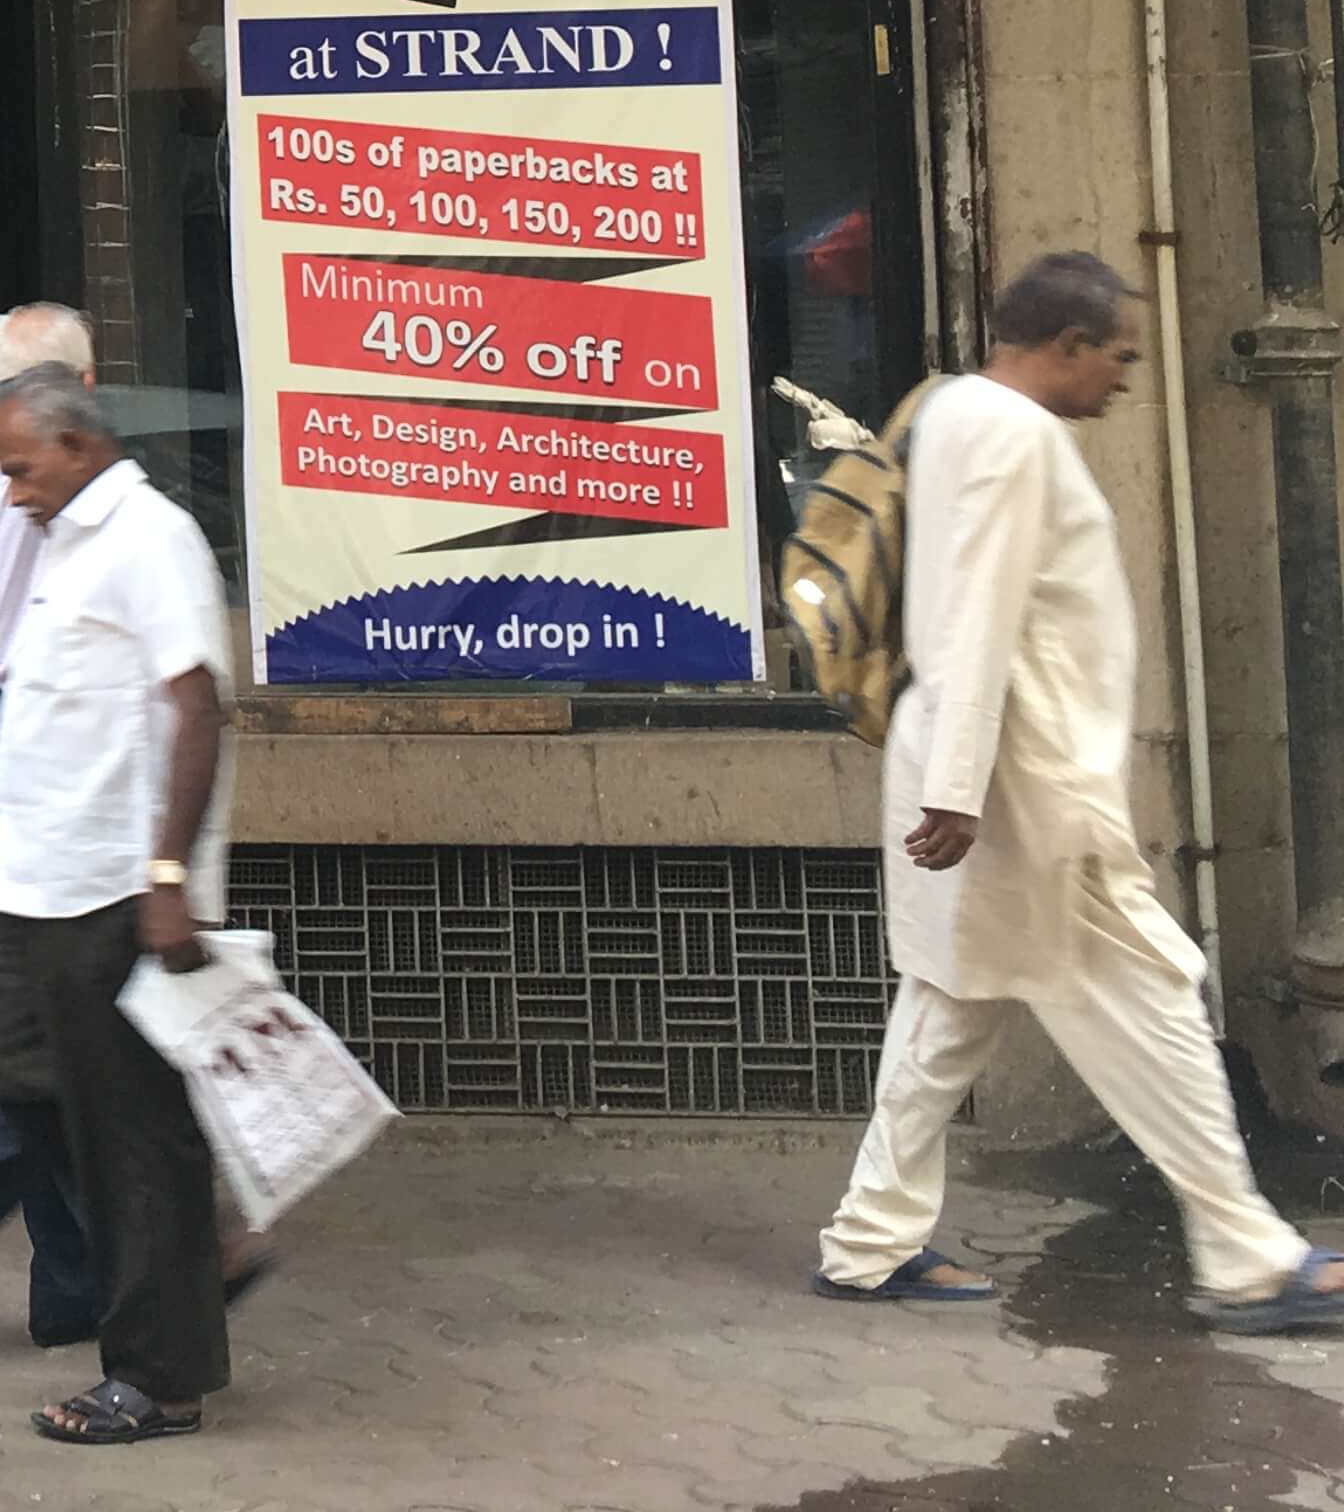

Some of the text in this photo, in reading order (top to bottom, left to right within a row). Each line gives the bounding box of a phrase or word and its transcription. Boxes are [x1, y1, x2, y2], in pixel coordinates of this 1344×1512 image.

[289, 37, 337, 80] at
[355, 25, 634, 78] STRAND
[267, 126, 687, 192] 100s of paperbacks at
[270, 177, 327, 215] Rs.
[339, 185, 397, 226] 50,
[410, 190, 489, 232] 100,
[501, 199, 581, 242] 150,
[301, 263, 483, 309] Minimum
[361, 310, 700, 390] 40% off on
[303, 408, 705, 473] Art, Design, Architecture,
[298, 447, 498, 494] Photography
[508, 463, 567, 497] and
[576, 476, 660, 506] more
[364, 618, 483, 656] Hurry,
[496, 614, 590, 656] drop
[603, 615, 640, 648] in
